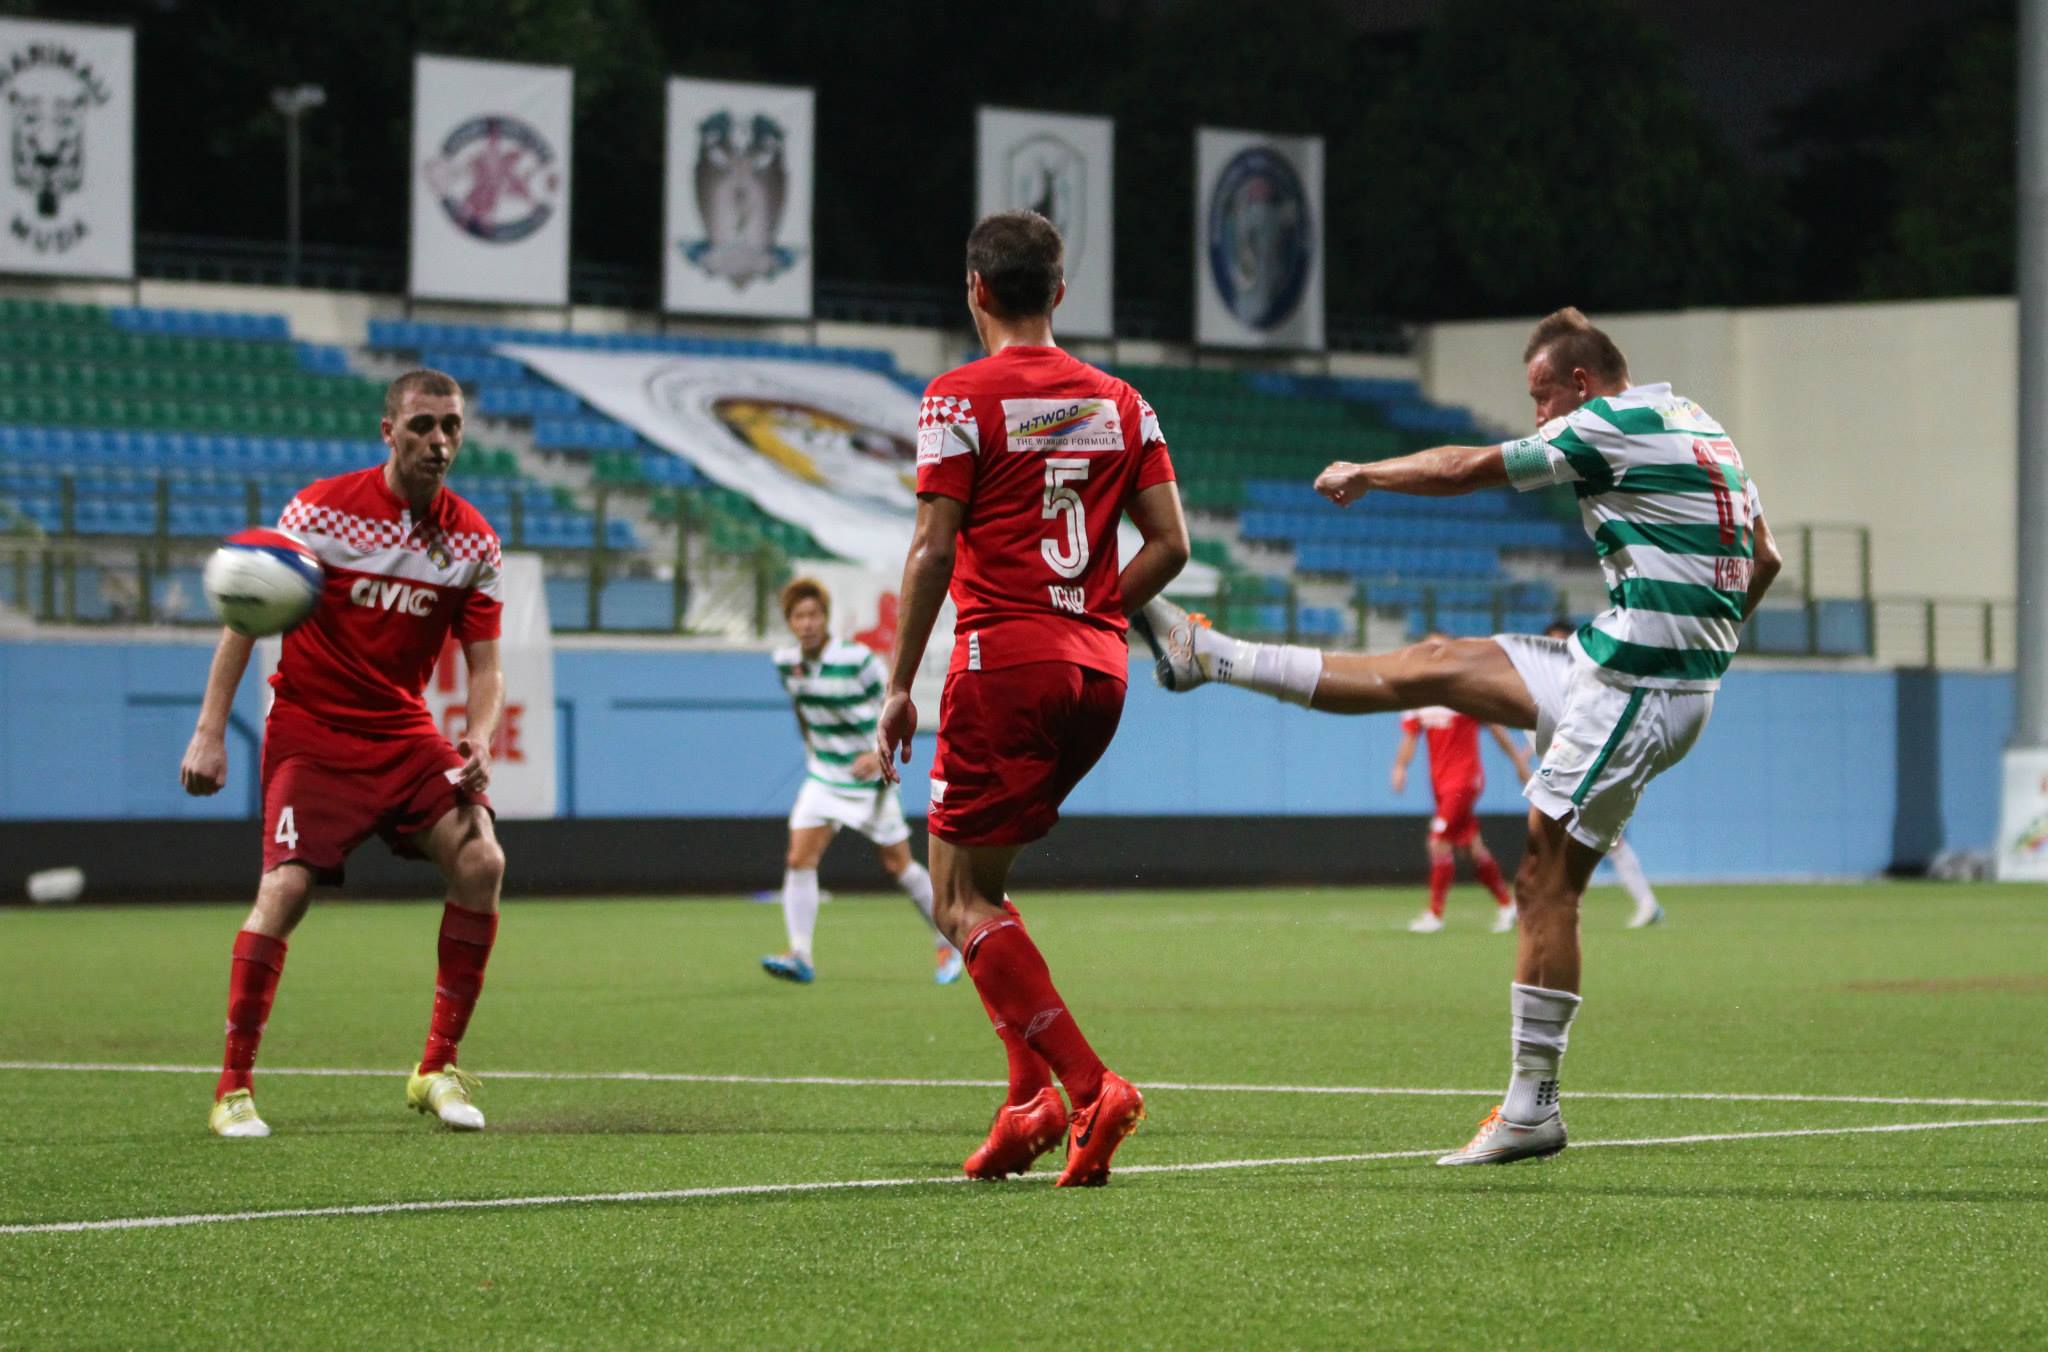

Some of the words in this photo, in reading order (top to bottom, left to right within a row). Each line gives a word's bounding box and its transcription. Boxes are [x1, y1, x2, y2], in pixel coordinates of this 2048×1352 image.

[1015, 438, 1033, 446] THE
[1071, 437, 1118, 446] FORMULA
[1041, 458, 1091, 579] 5
[274, 806, 299, 849] 4
